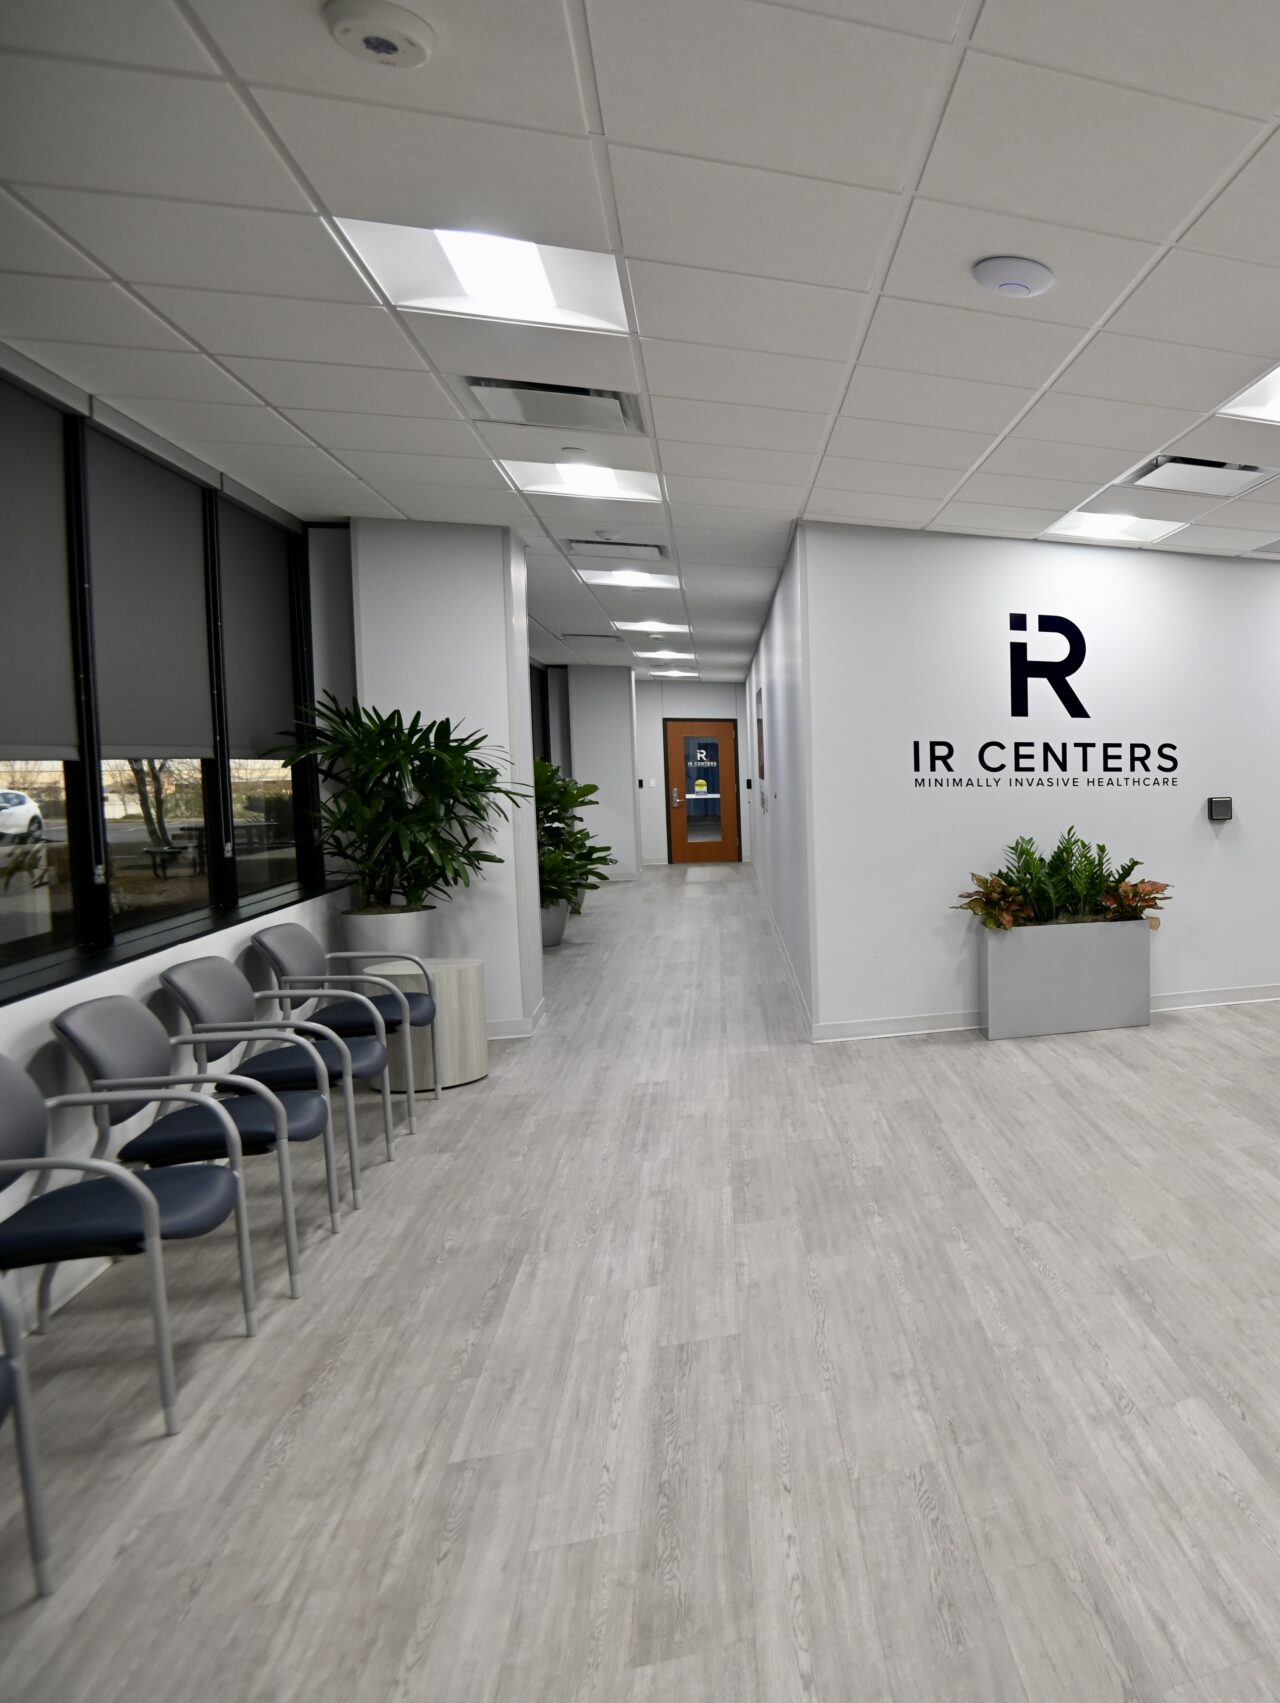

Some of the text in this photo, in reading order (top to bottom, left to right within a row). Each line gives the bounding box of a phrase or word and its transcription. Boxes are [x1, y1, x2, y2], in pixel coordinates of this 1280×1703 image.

[912, 740, 1179, 773] IR CENTERS
[914, 776, 1179, 788] MINIMALLY INVASIVE HEALTHCARE
